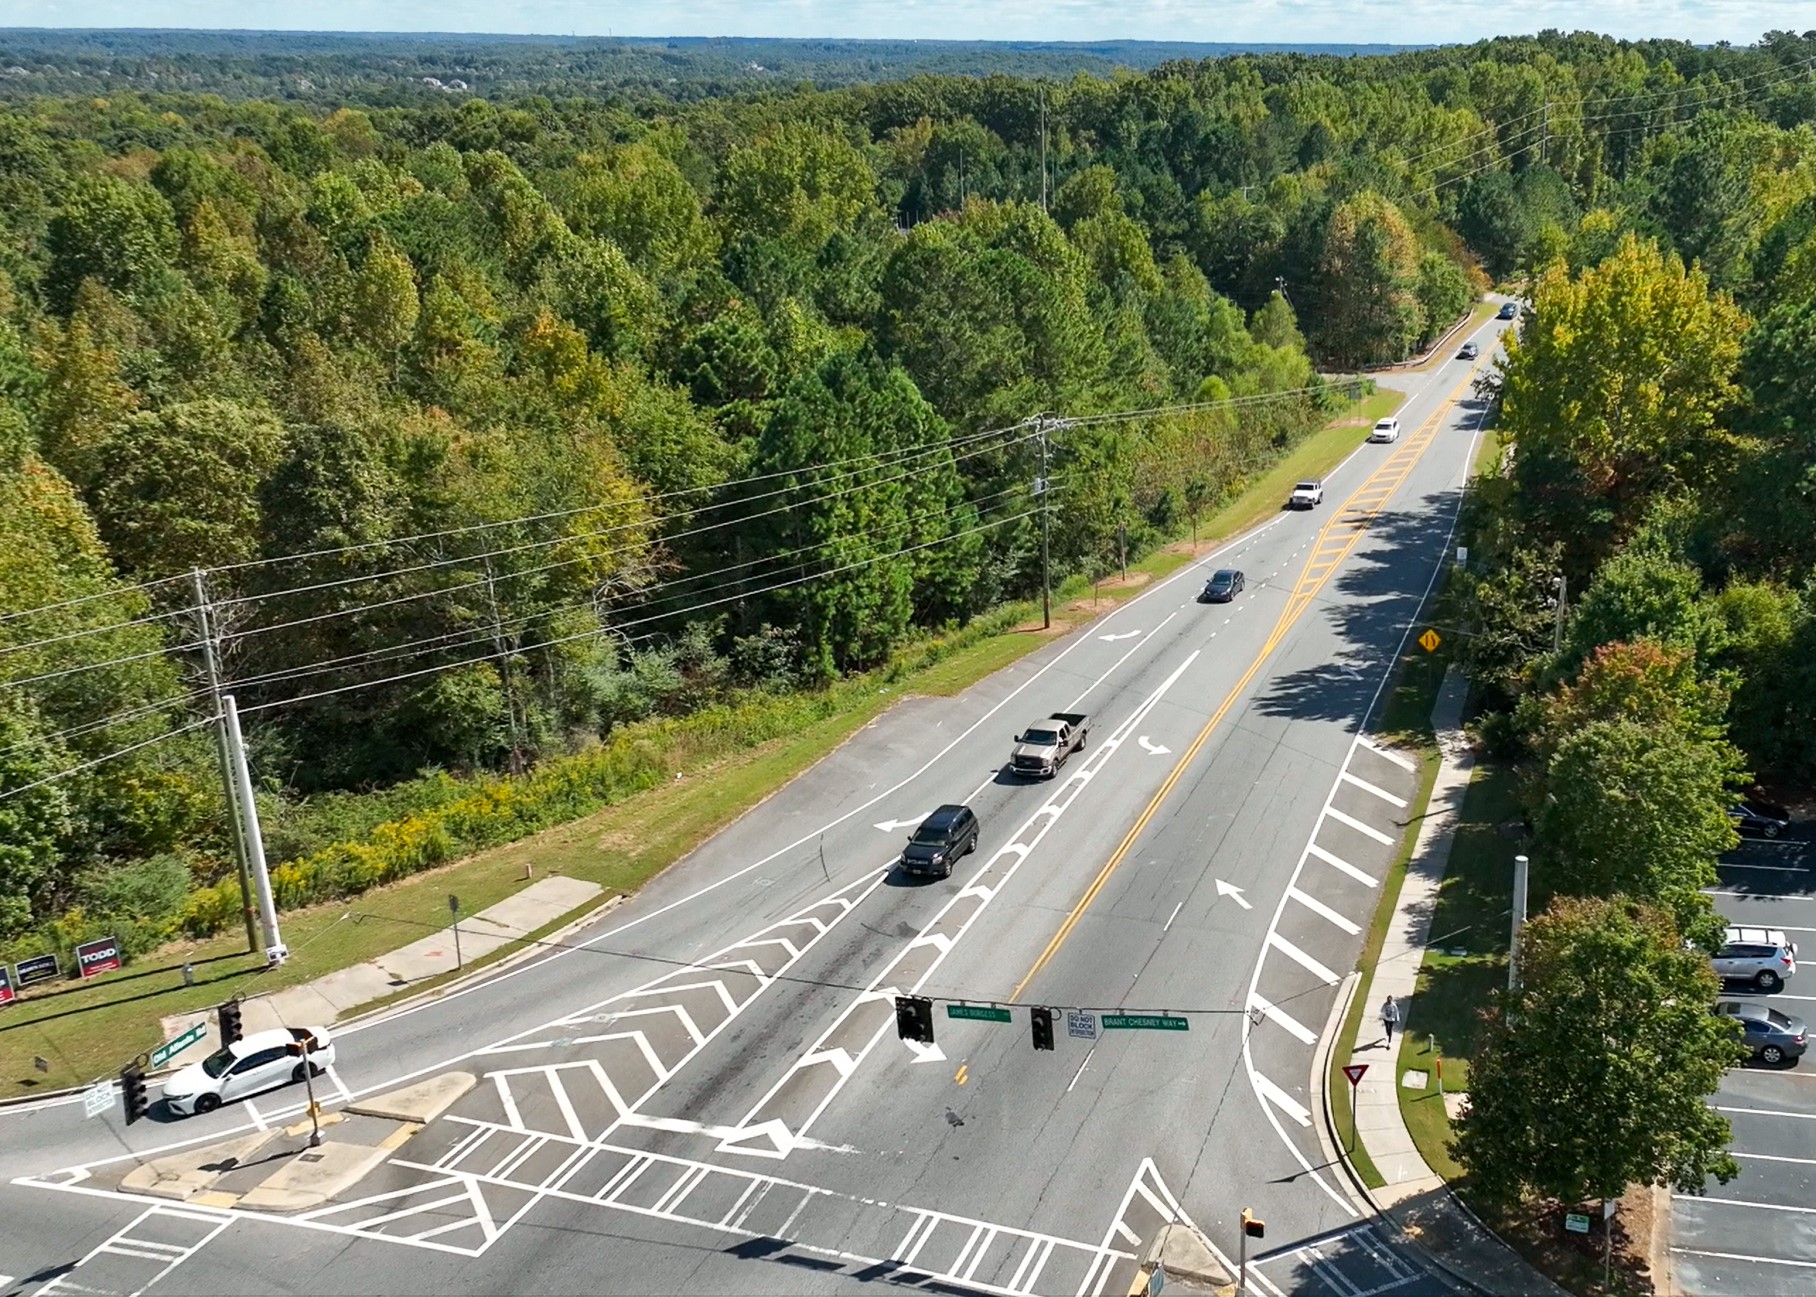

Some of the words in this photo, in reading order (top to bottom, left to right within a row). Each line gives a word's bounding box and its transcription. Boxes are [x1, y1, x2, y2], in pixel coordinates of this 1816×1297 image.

[81, 948, 116, 964] TODD
[1070, 1014, 1080, 1022] DO
[1081, 1016, 1093, 1024] NOT
[1162, 1019, 1178, 1028] WAY
[1070, 1021, 1093, 1030] BLOCK
[153, 1049, 167, 1064] Old
